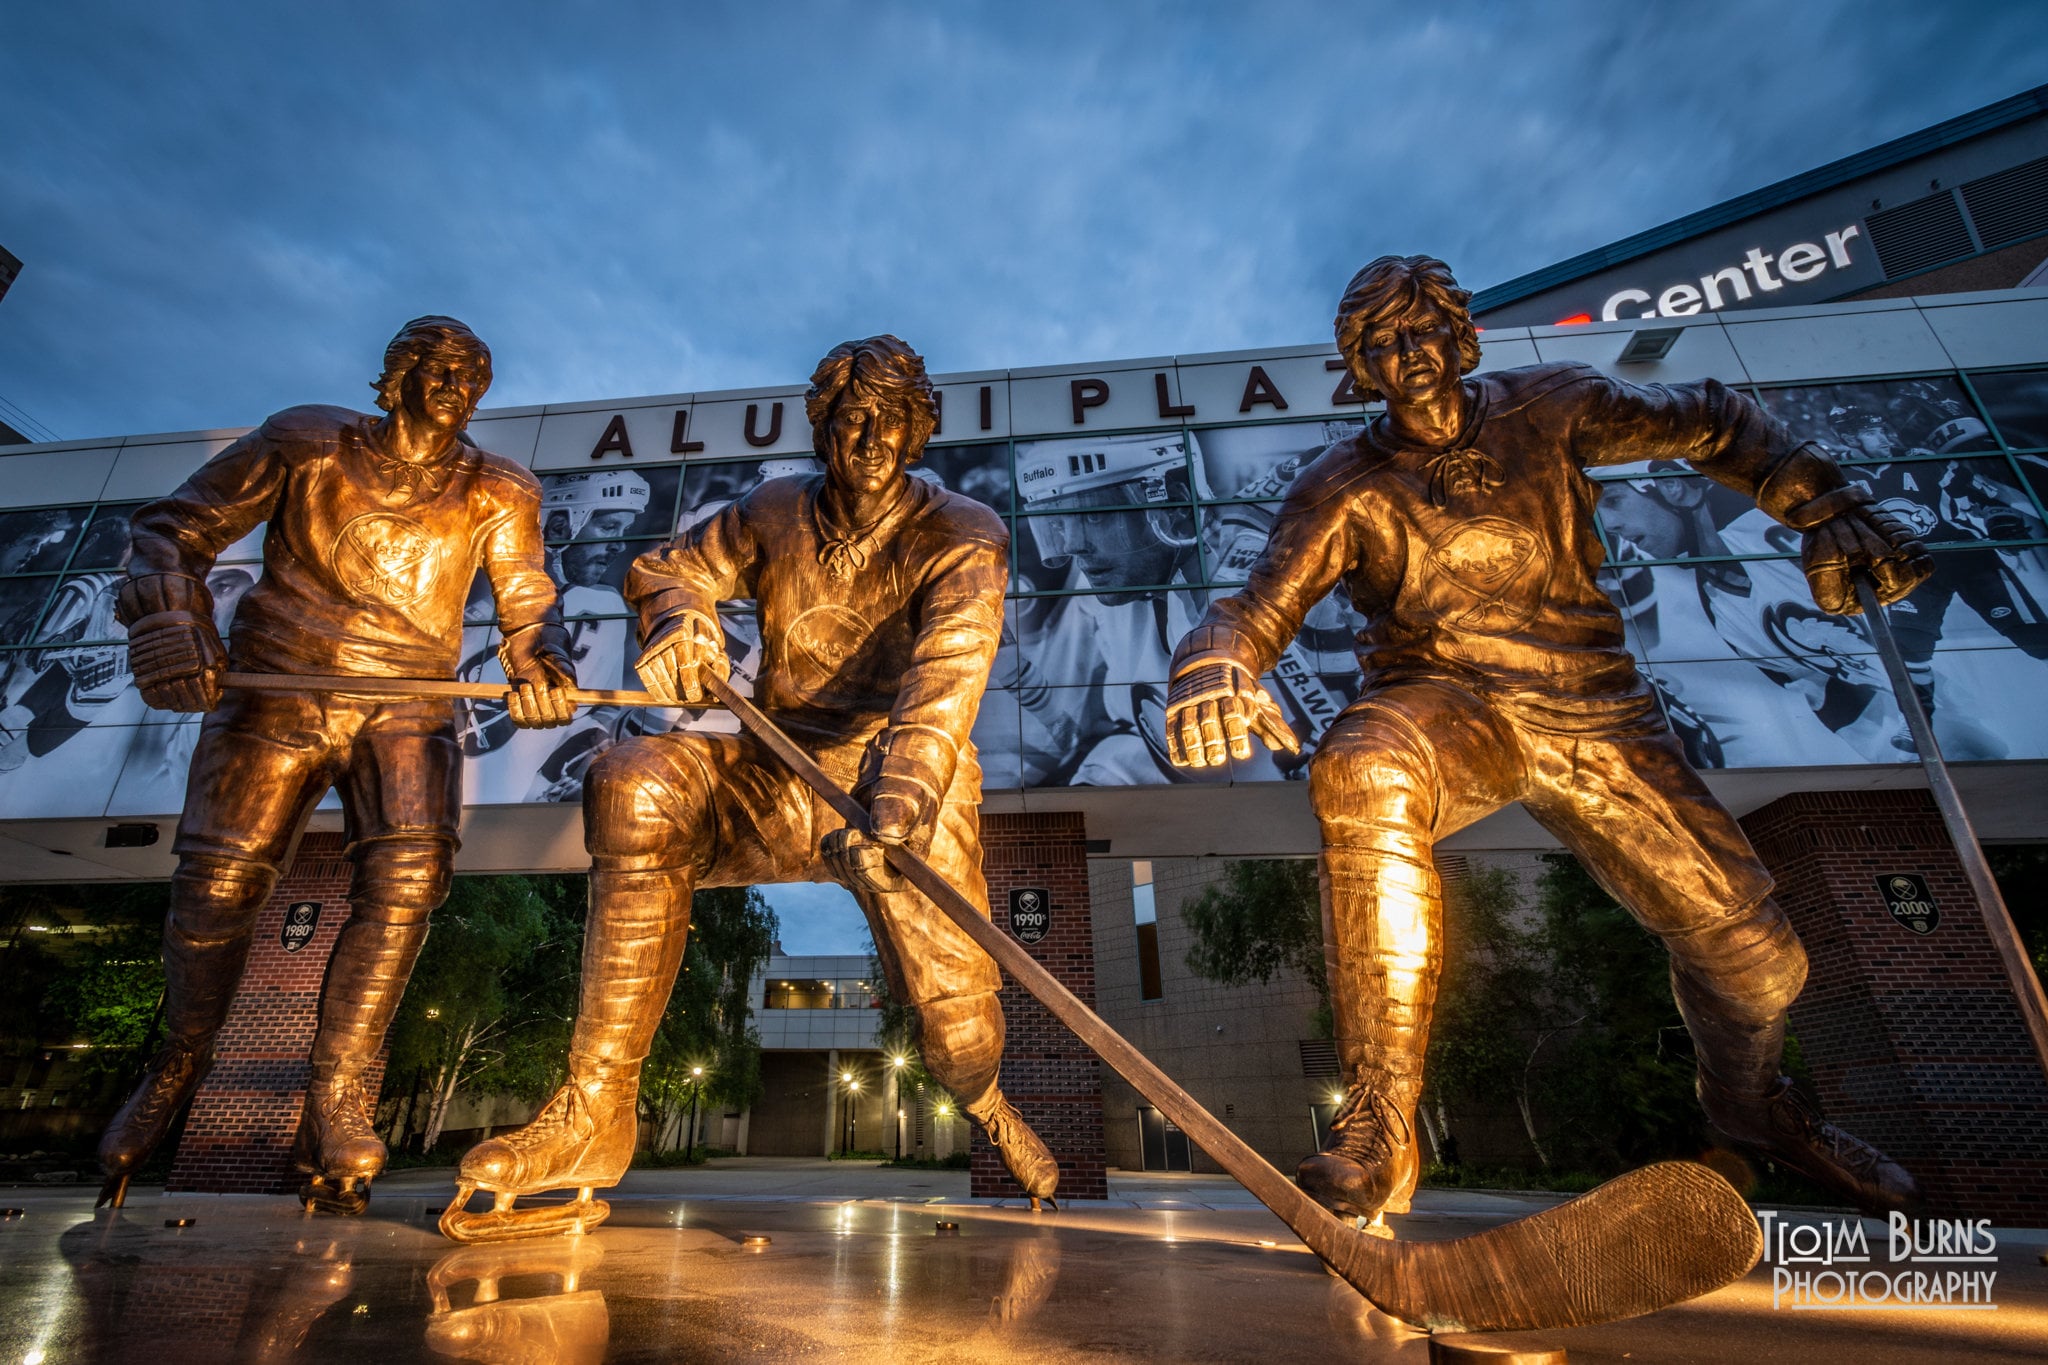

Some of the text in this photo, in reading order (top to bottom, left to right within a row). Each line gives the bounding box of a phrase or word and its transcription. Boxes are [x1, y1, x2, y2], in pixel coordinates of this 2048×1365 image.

[1602, 225, 1859, 322] Center
[590, 359, 1378, 459] ALUI PLAZ
[1023, 467, 1055, 484] Buffalo
